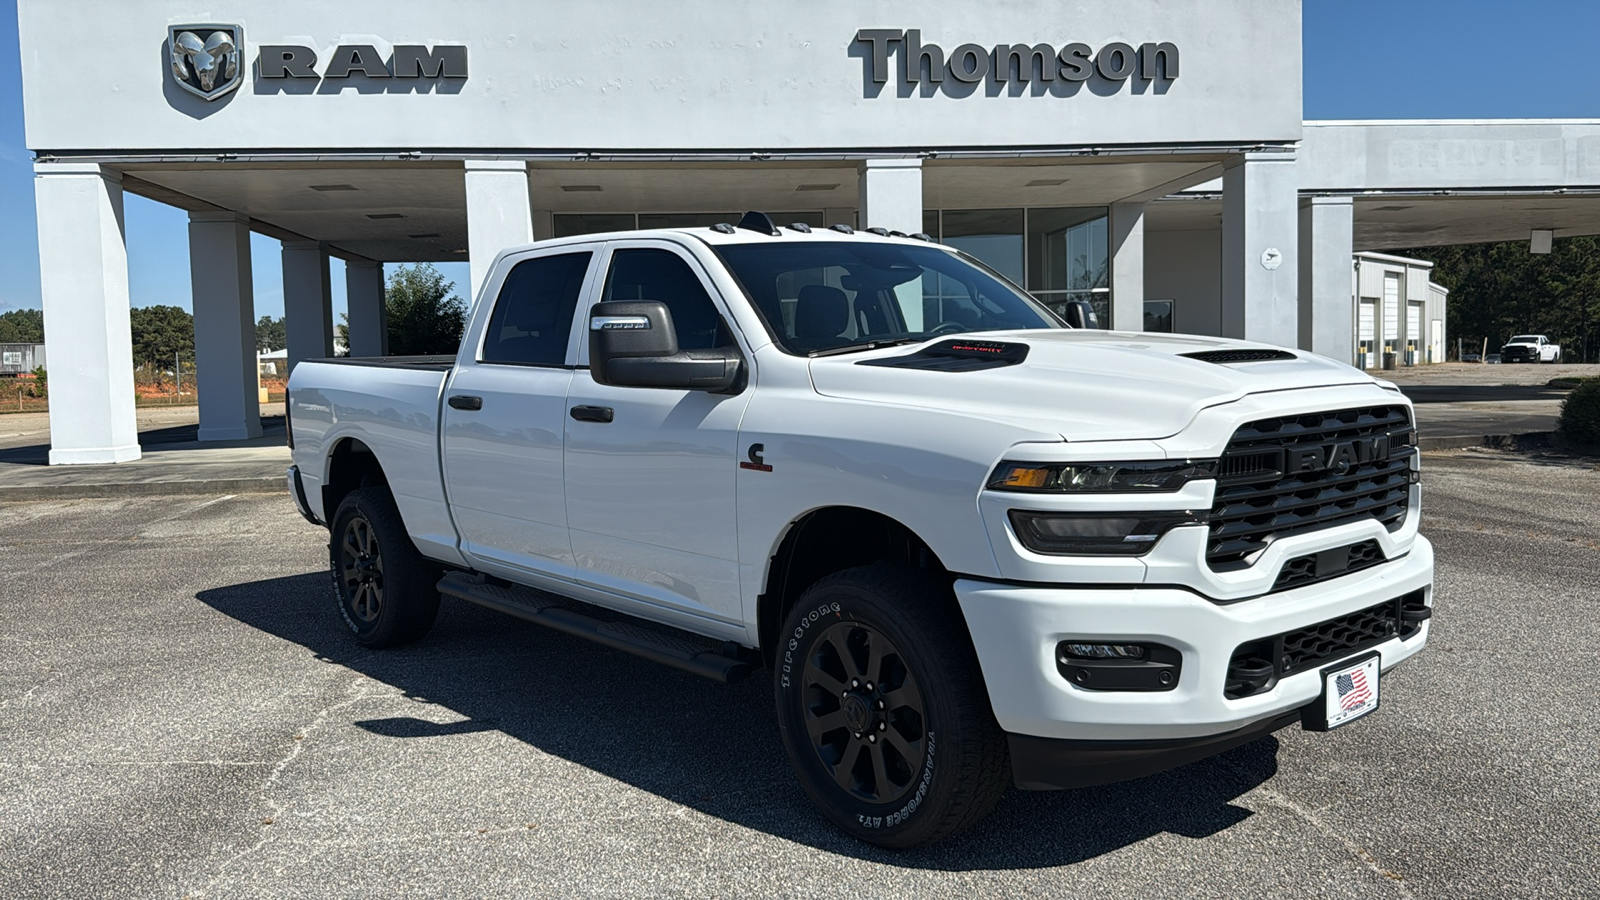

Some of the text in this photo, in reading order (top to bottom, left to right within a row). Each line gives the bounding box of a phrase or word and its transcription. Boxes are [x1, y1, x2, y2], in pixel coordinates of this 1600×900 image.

[258, 44, 469, 79] RAM
[857, 28, 1180, 83] Thomson
[1287, 435, 1388, 474] RAM
[781, 602, 841, 688] Firestone
[886, 730, 936, 827] TRANSFORCE
